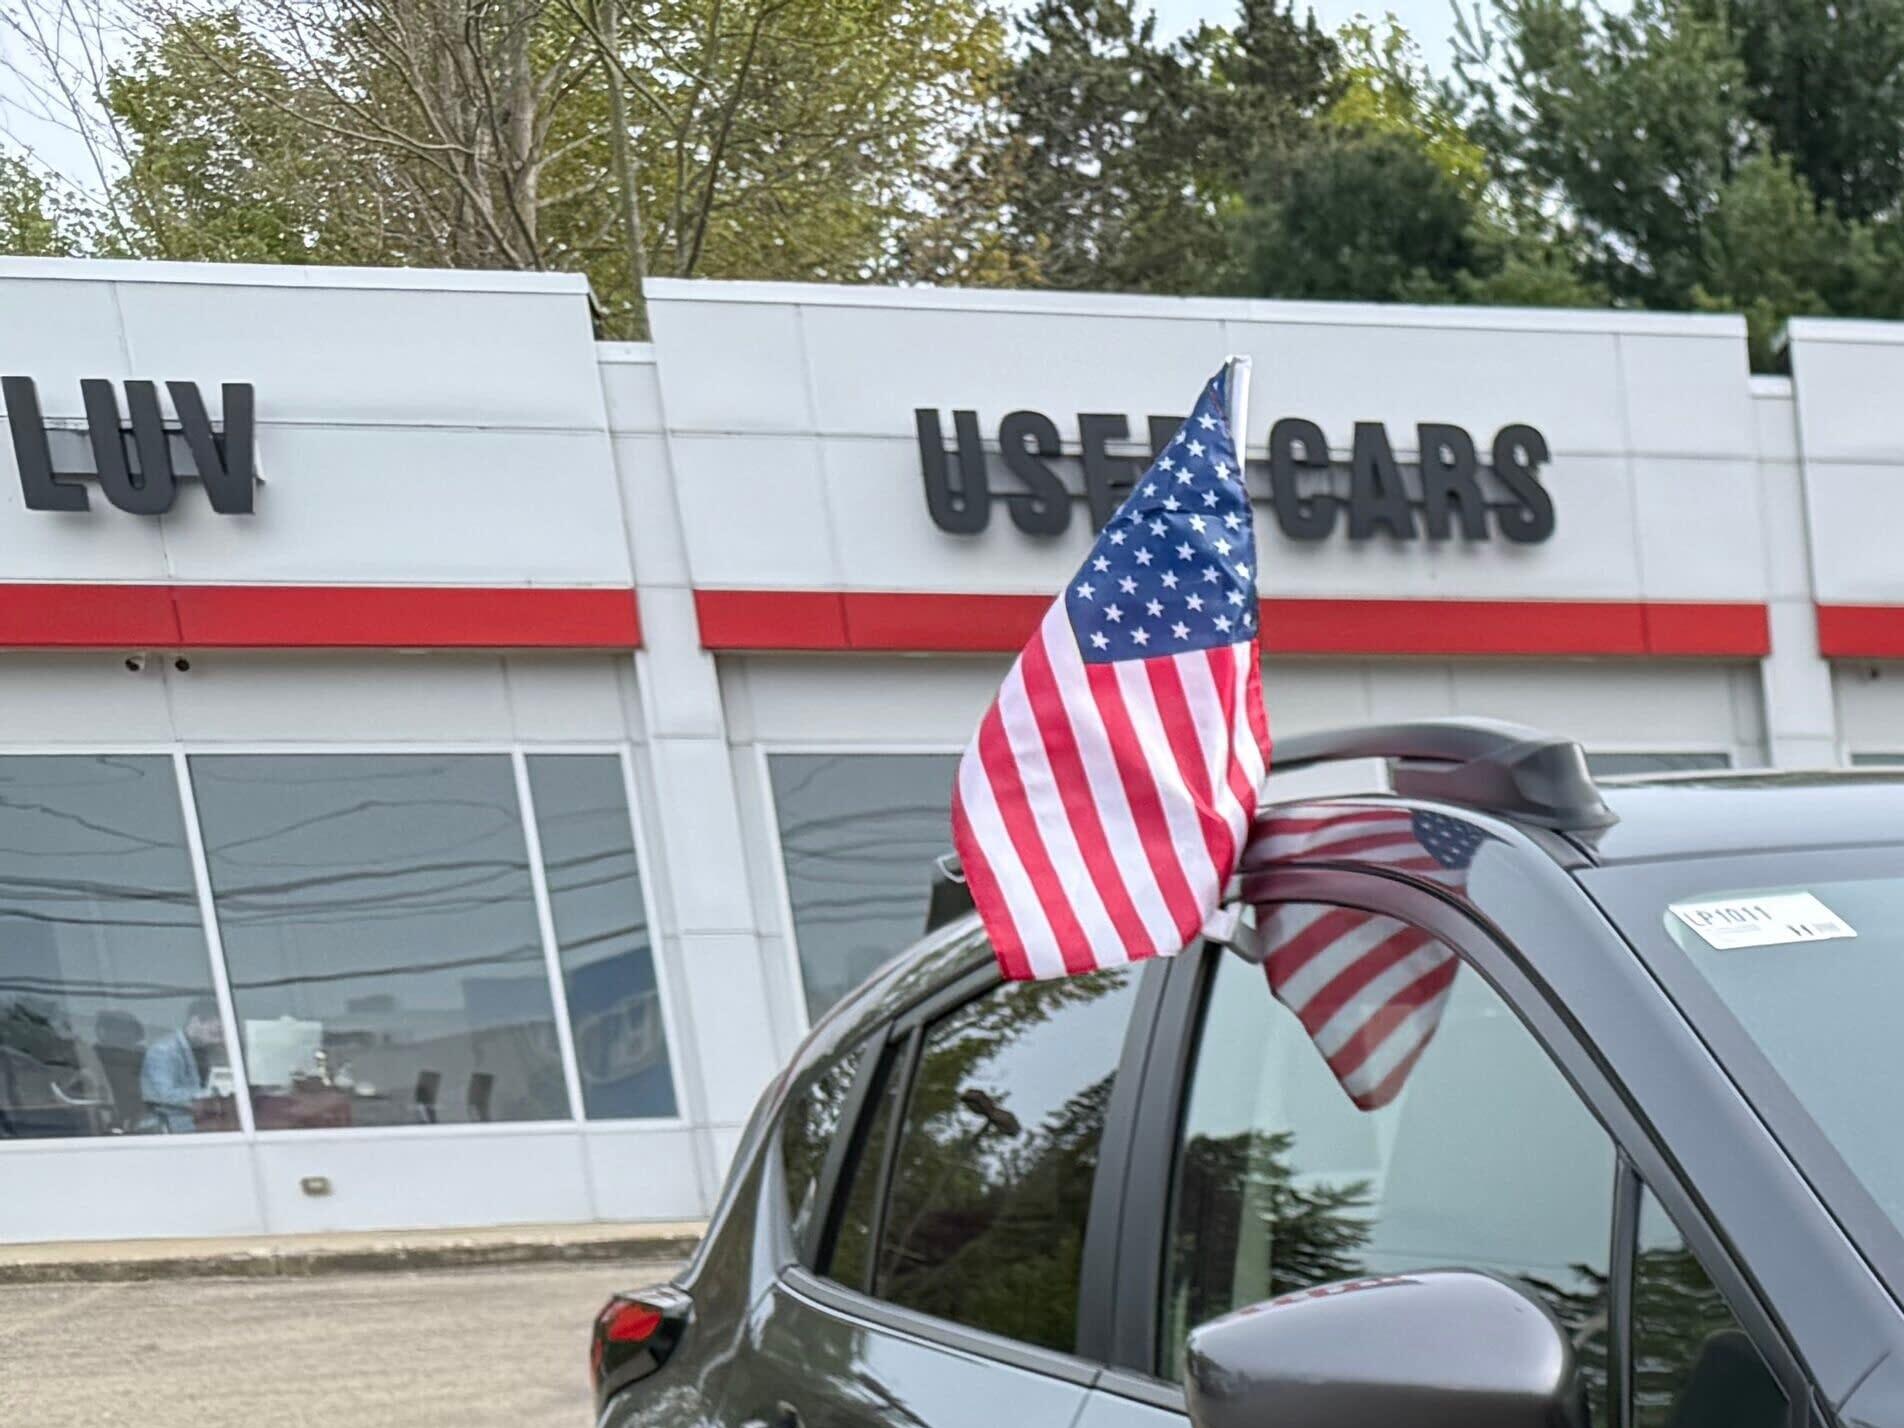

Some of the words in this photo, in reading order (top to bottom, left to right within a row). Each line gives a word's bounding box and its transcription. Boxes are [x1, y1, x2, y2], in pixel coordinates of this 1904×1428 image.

[1, 376, 254, 515] LUV
[914, 408, 1195, 536] USE
[1268, 416, 1555, 545] CARS
